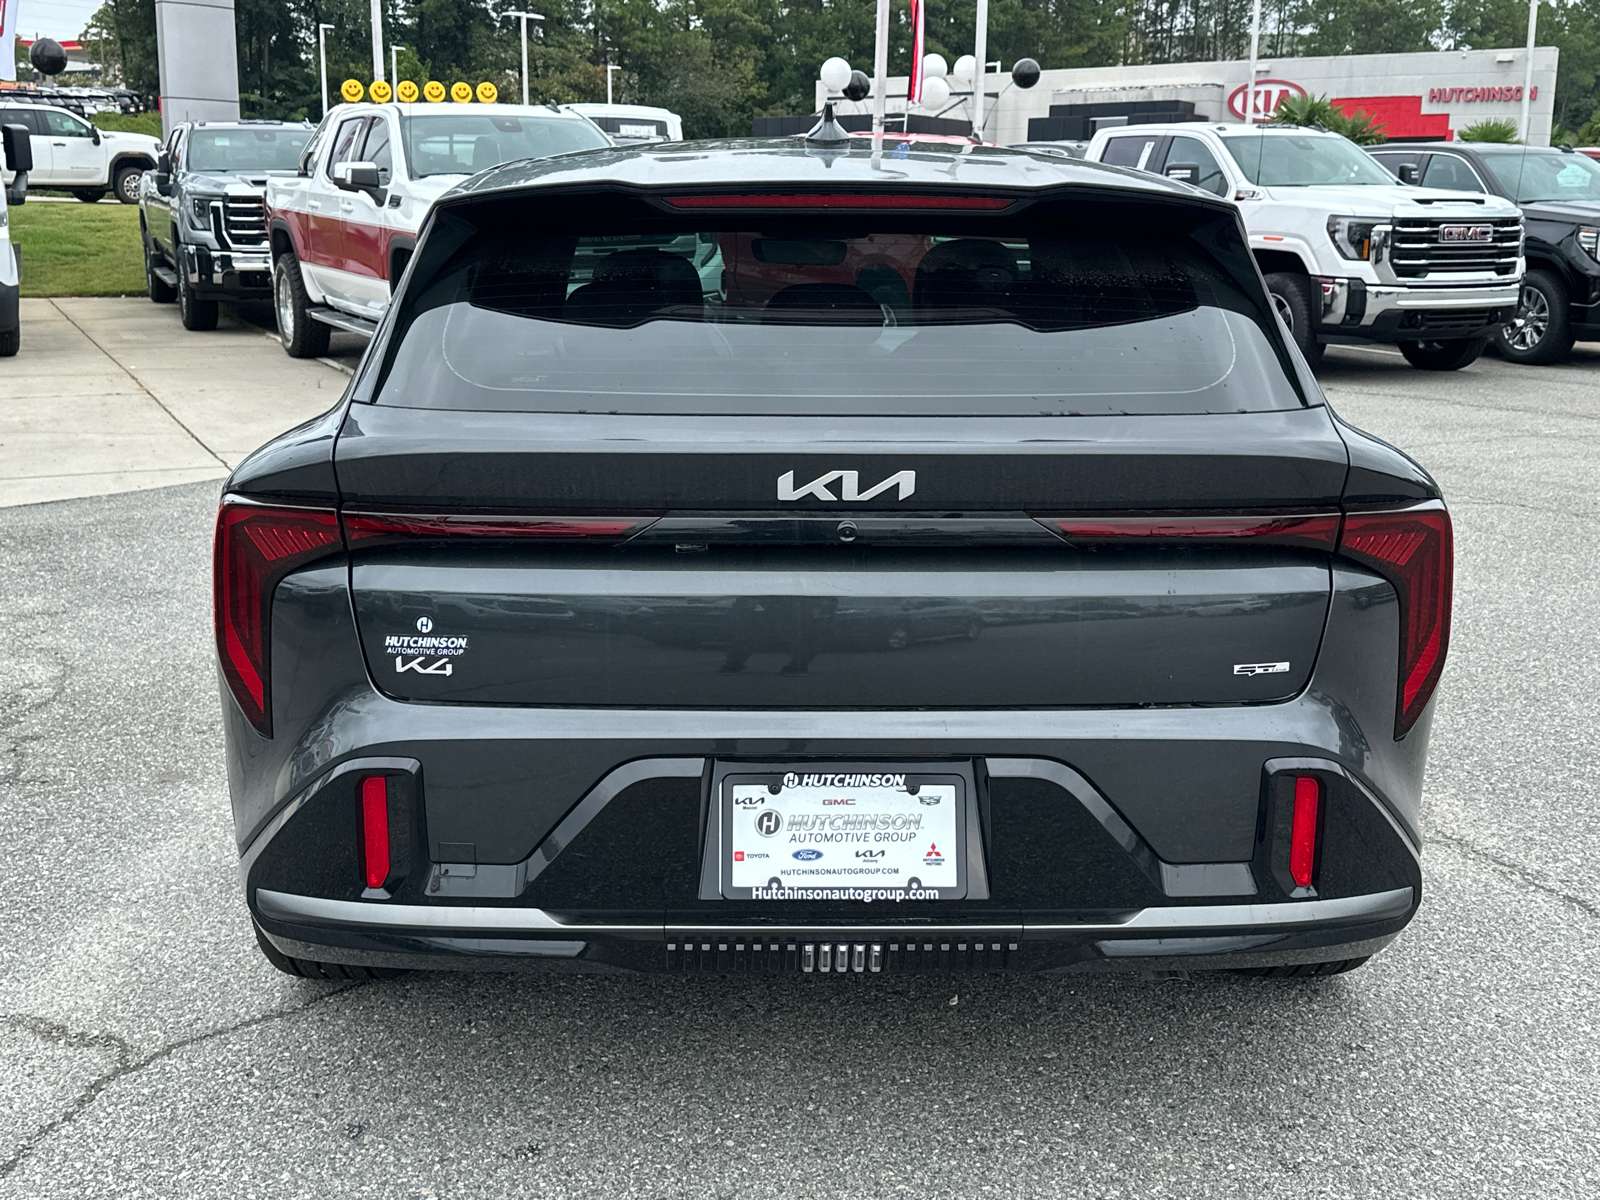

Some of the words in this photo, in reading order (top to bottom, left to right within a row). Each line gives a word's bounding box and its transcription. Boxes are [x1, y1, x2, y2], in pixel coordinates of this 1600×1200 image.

[1429, 86, 1538, 103] HUTCHINSON
[1444, 226, 1492, 240] GMC
[777, 470, 915, 501] KIA
[385, 635, 467, 648] HUTCHINSON
[387, 647, 435, 656] AUTOMOTIVE
[437, 648, 464, 656] GROUP
[395, 656, 452, 676] K4
[801, 773, 906, 788] HUTCHINSON
[735, 797, 765, 805] KIA
[787, 814, 922, 832] HUTCHINSON
[789, 832, 870, 843] AUTOMOTIVE
[874, 832, 917, 842] GROUP
[855, 850, 885, 858] KIA
[780, 868, 900, 876] HUTCHINSONAUTOGROUP.COM
[752, 887, 939, 902] Hutchinsonautogroup.com
